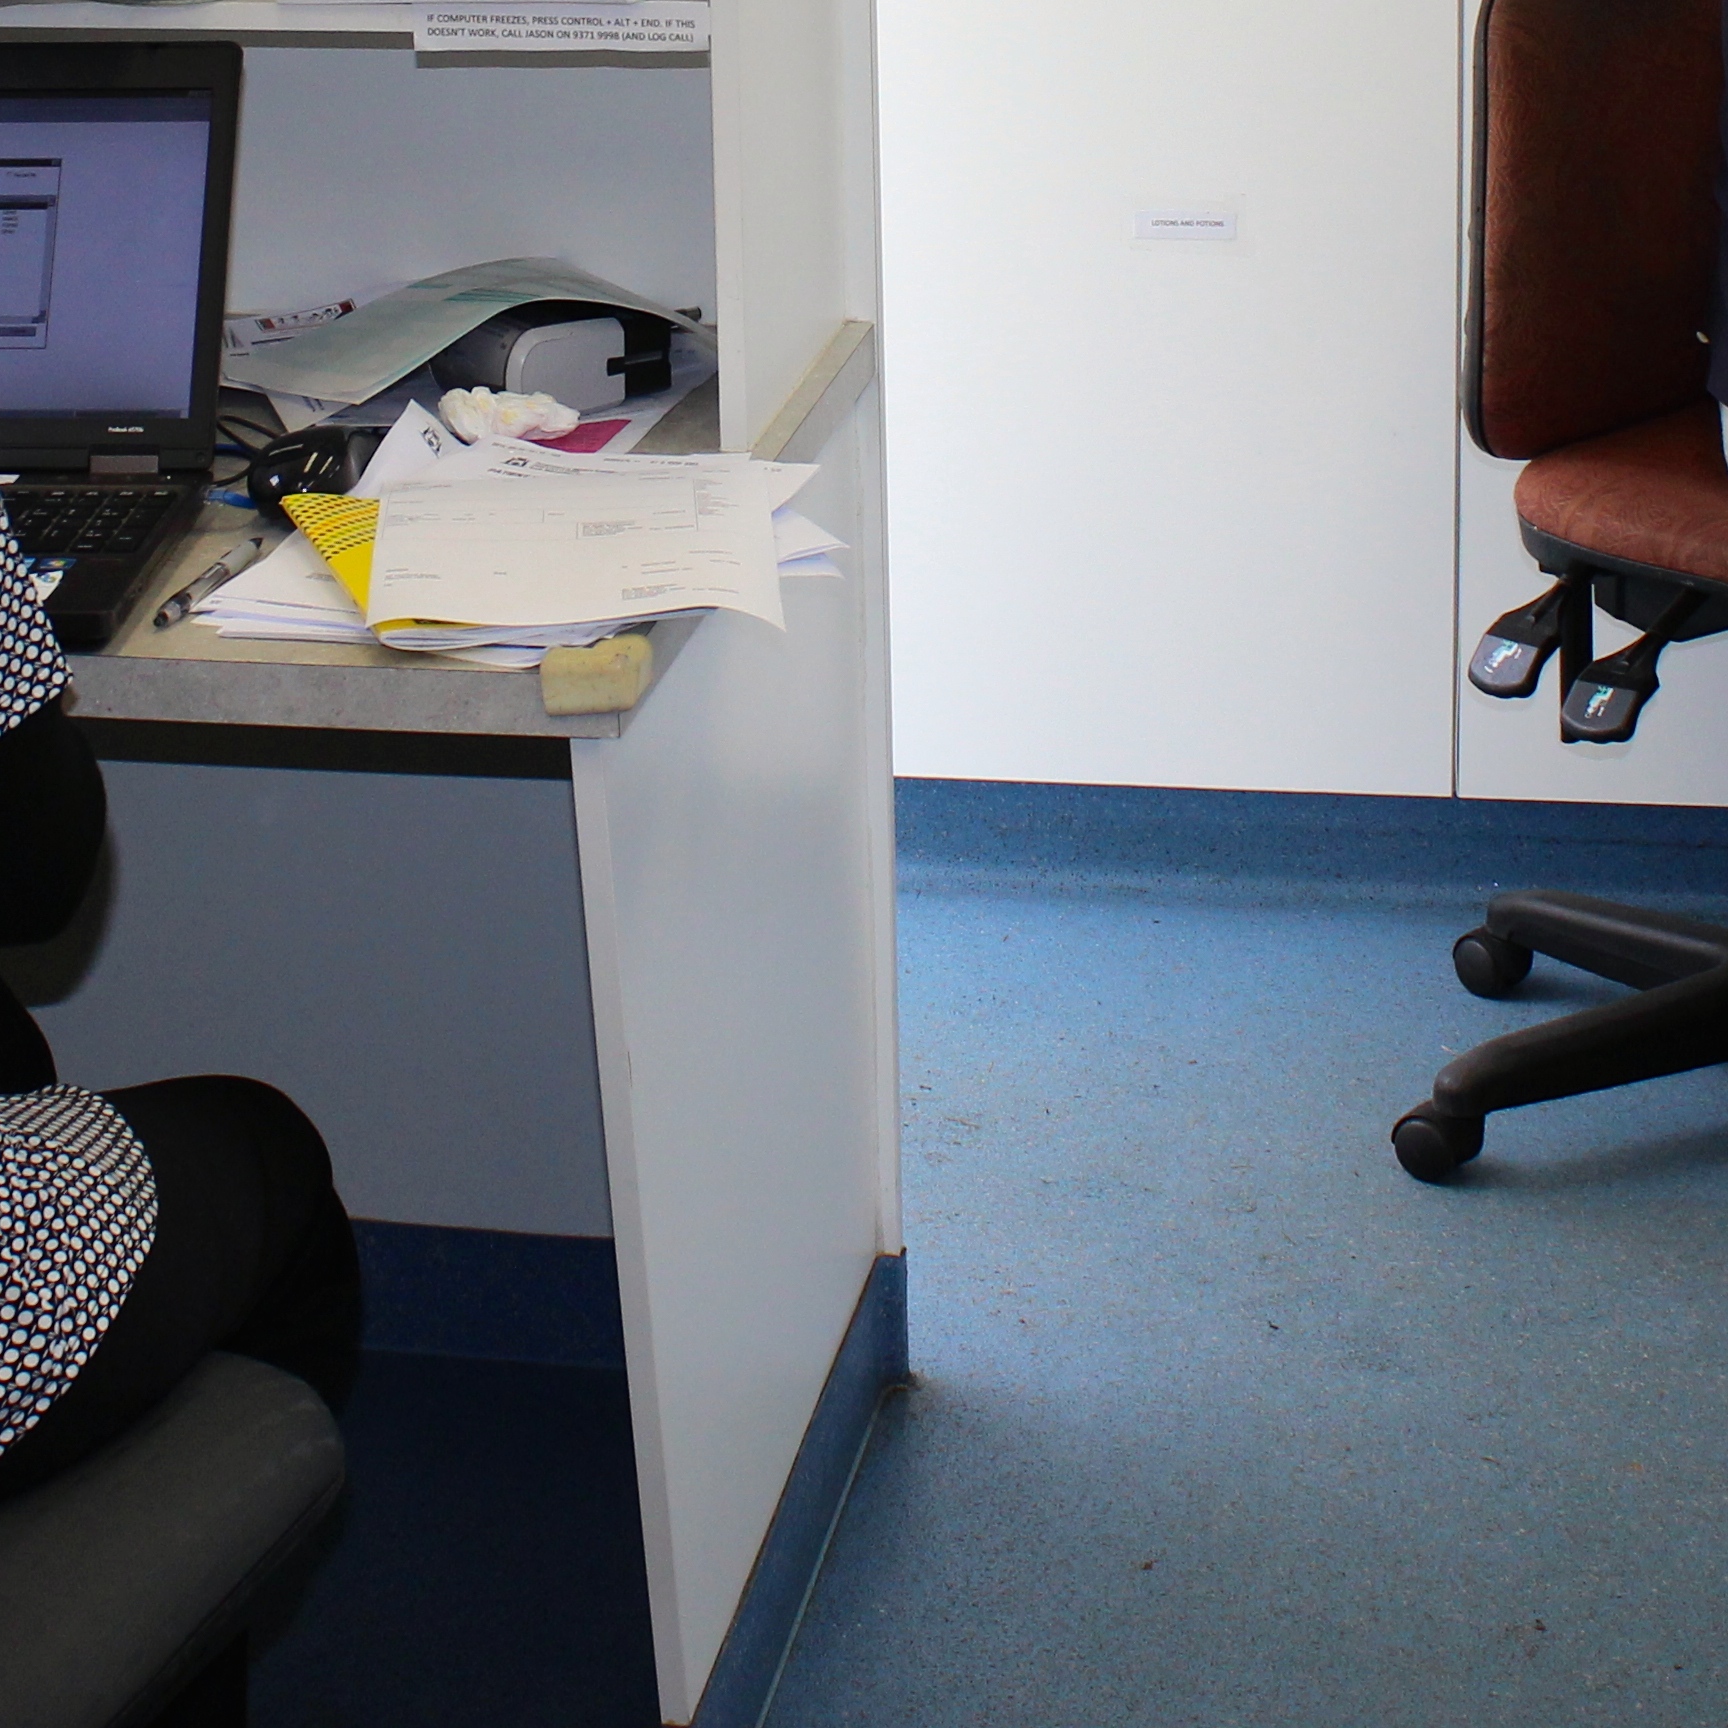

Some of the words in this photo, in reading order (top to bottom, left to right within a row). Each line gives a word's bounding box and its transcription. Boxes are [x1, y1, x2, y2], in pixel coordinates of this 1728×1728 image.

[437, 15, 487, 23] COMPUTER
[491, 16, 530, 26] FREEZES,
[532, 17, 559, 25] PRESS
[561, 17, 604, 26] CONTROL
[641, 19, 662, 27] END.
[665, 19, 672, 27] IF
[676, 20, 695, 28] THIS
[428, 28, 465, 36] DOESN'T
[468, 29, 499, 38] WORK,
[502, 29, 523, 38] CALL
[525, 30, 553, 38] JASON
[557, 30, 570, 38] ON
[573, 31, 594, 40] 9371
[597, 31, 619, 40] 9998
[622, 32, 645, 41] (AND
[648, 33, 666, 41] LOG
[669, 33, 694, 42] CALL)
